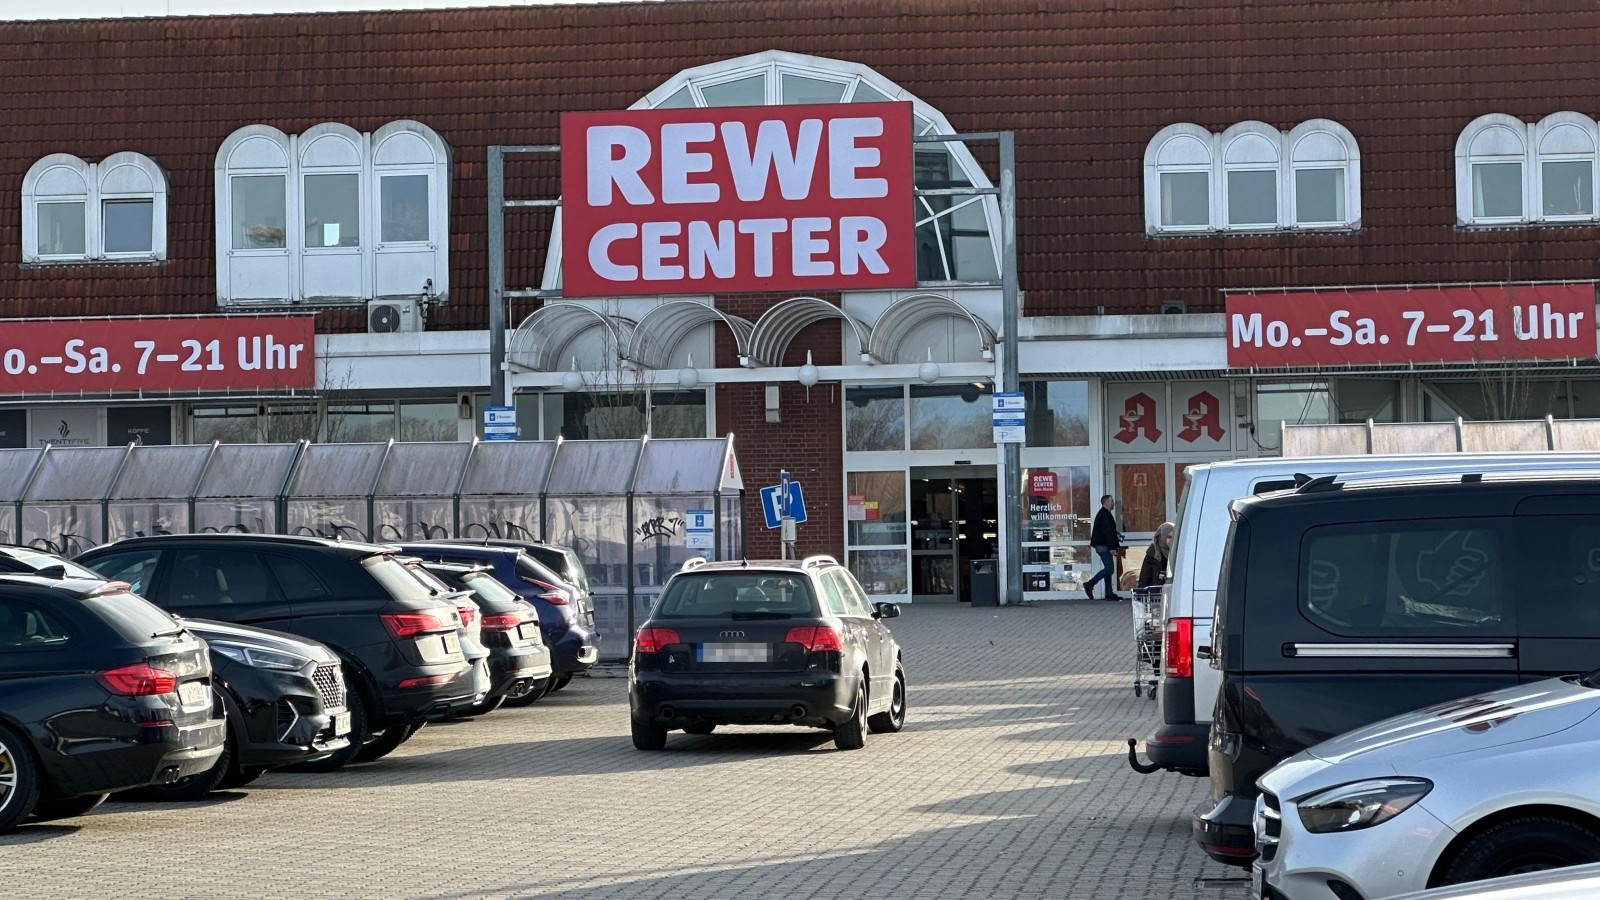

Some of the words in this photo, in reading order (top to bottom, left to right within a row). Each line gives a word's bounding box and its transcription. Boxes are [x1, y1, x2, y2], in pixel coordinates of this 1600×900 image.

[586, 117, 889, 206] REWE
[588, 216, 890, 281] CENTER
[1231, 310, 1390, 349] Mo.–Sa.
[1403, 308, 1498, 346] 7–21
[1513, 303, 1585, 341] Uhr
[3, 339, 121, 375] o.–Sa.
[134, 339, 225, 374] 7–21
[237, 335, 304, 371] Uhr
[1030, 503, 1062, 511] Herzlich
